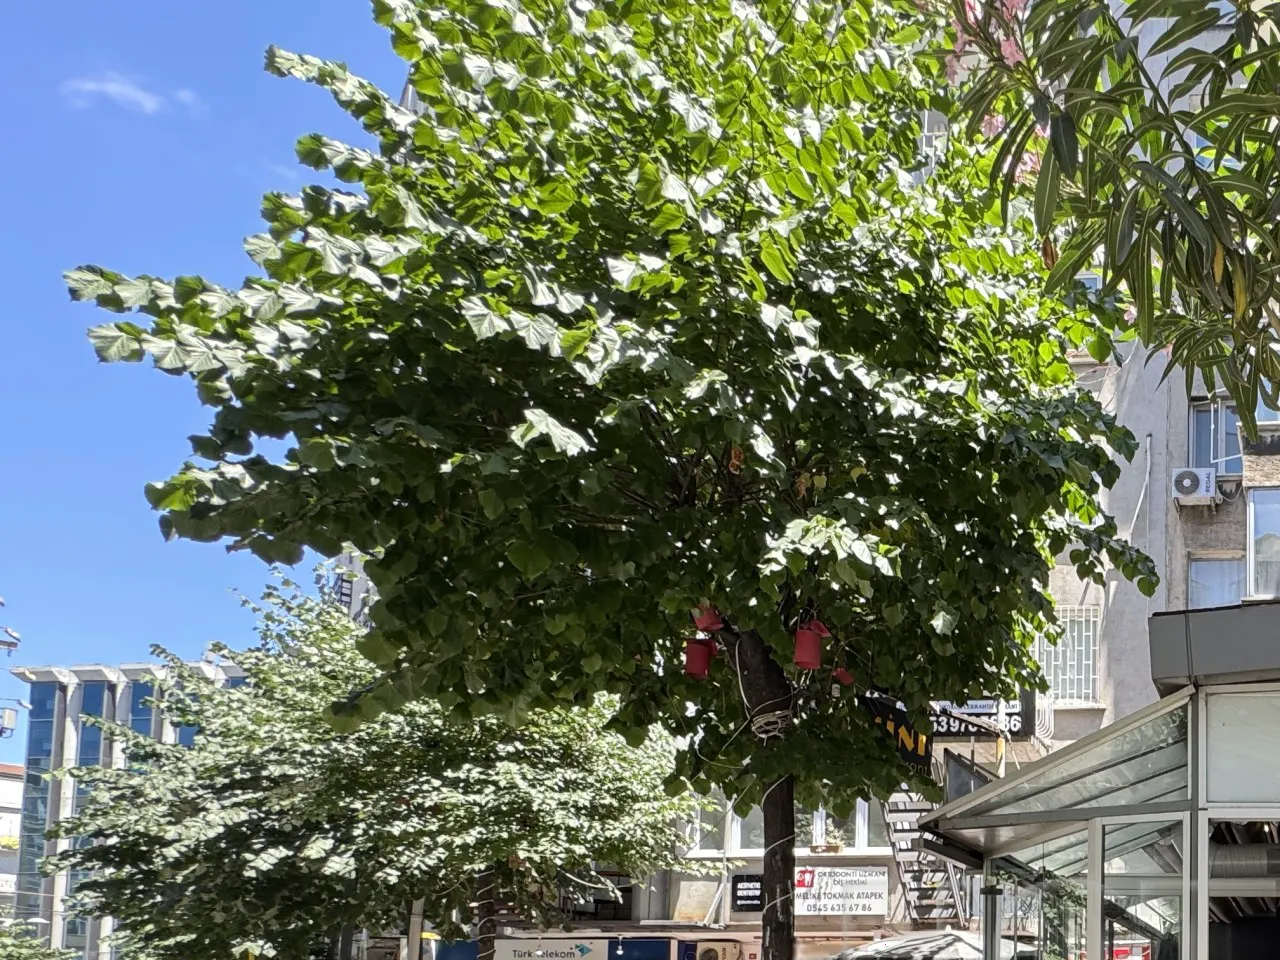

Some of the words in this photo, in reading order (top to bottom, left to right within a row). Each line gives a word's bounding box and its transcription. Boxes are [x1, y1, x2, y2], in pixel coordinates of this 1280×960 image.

[823, 892, 854, 900] TOKMAK
[856, 892, 883, 900] ATAPEK
[830, 904, 846, 912] 635
[848, 904, 859, 912] 67
[861, 904, 873, 912] 86
[512, 949, 532, 958] Türk
